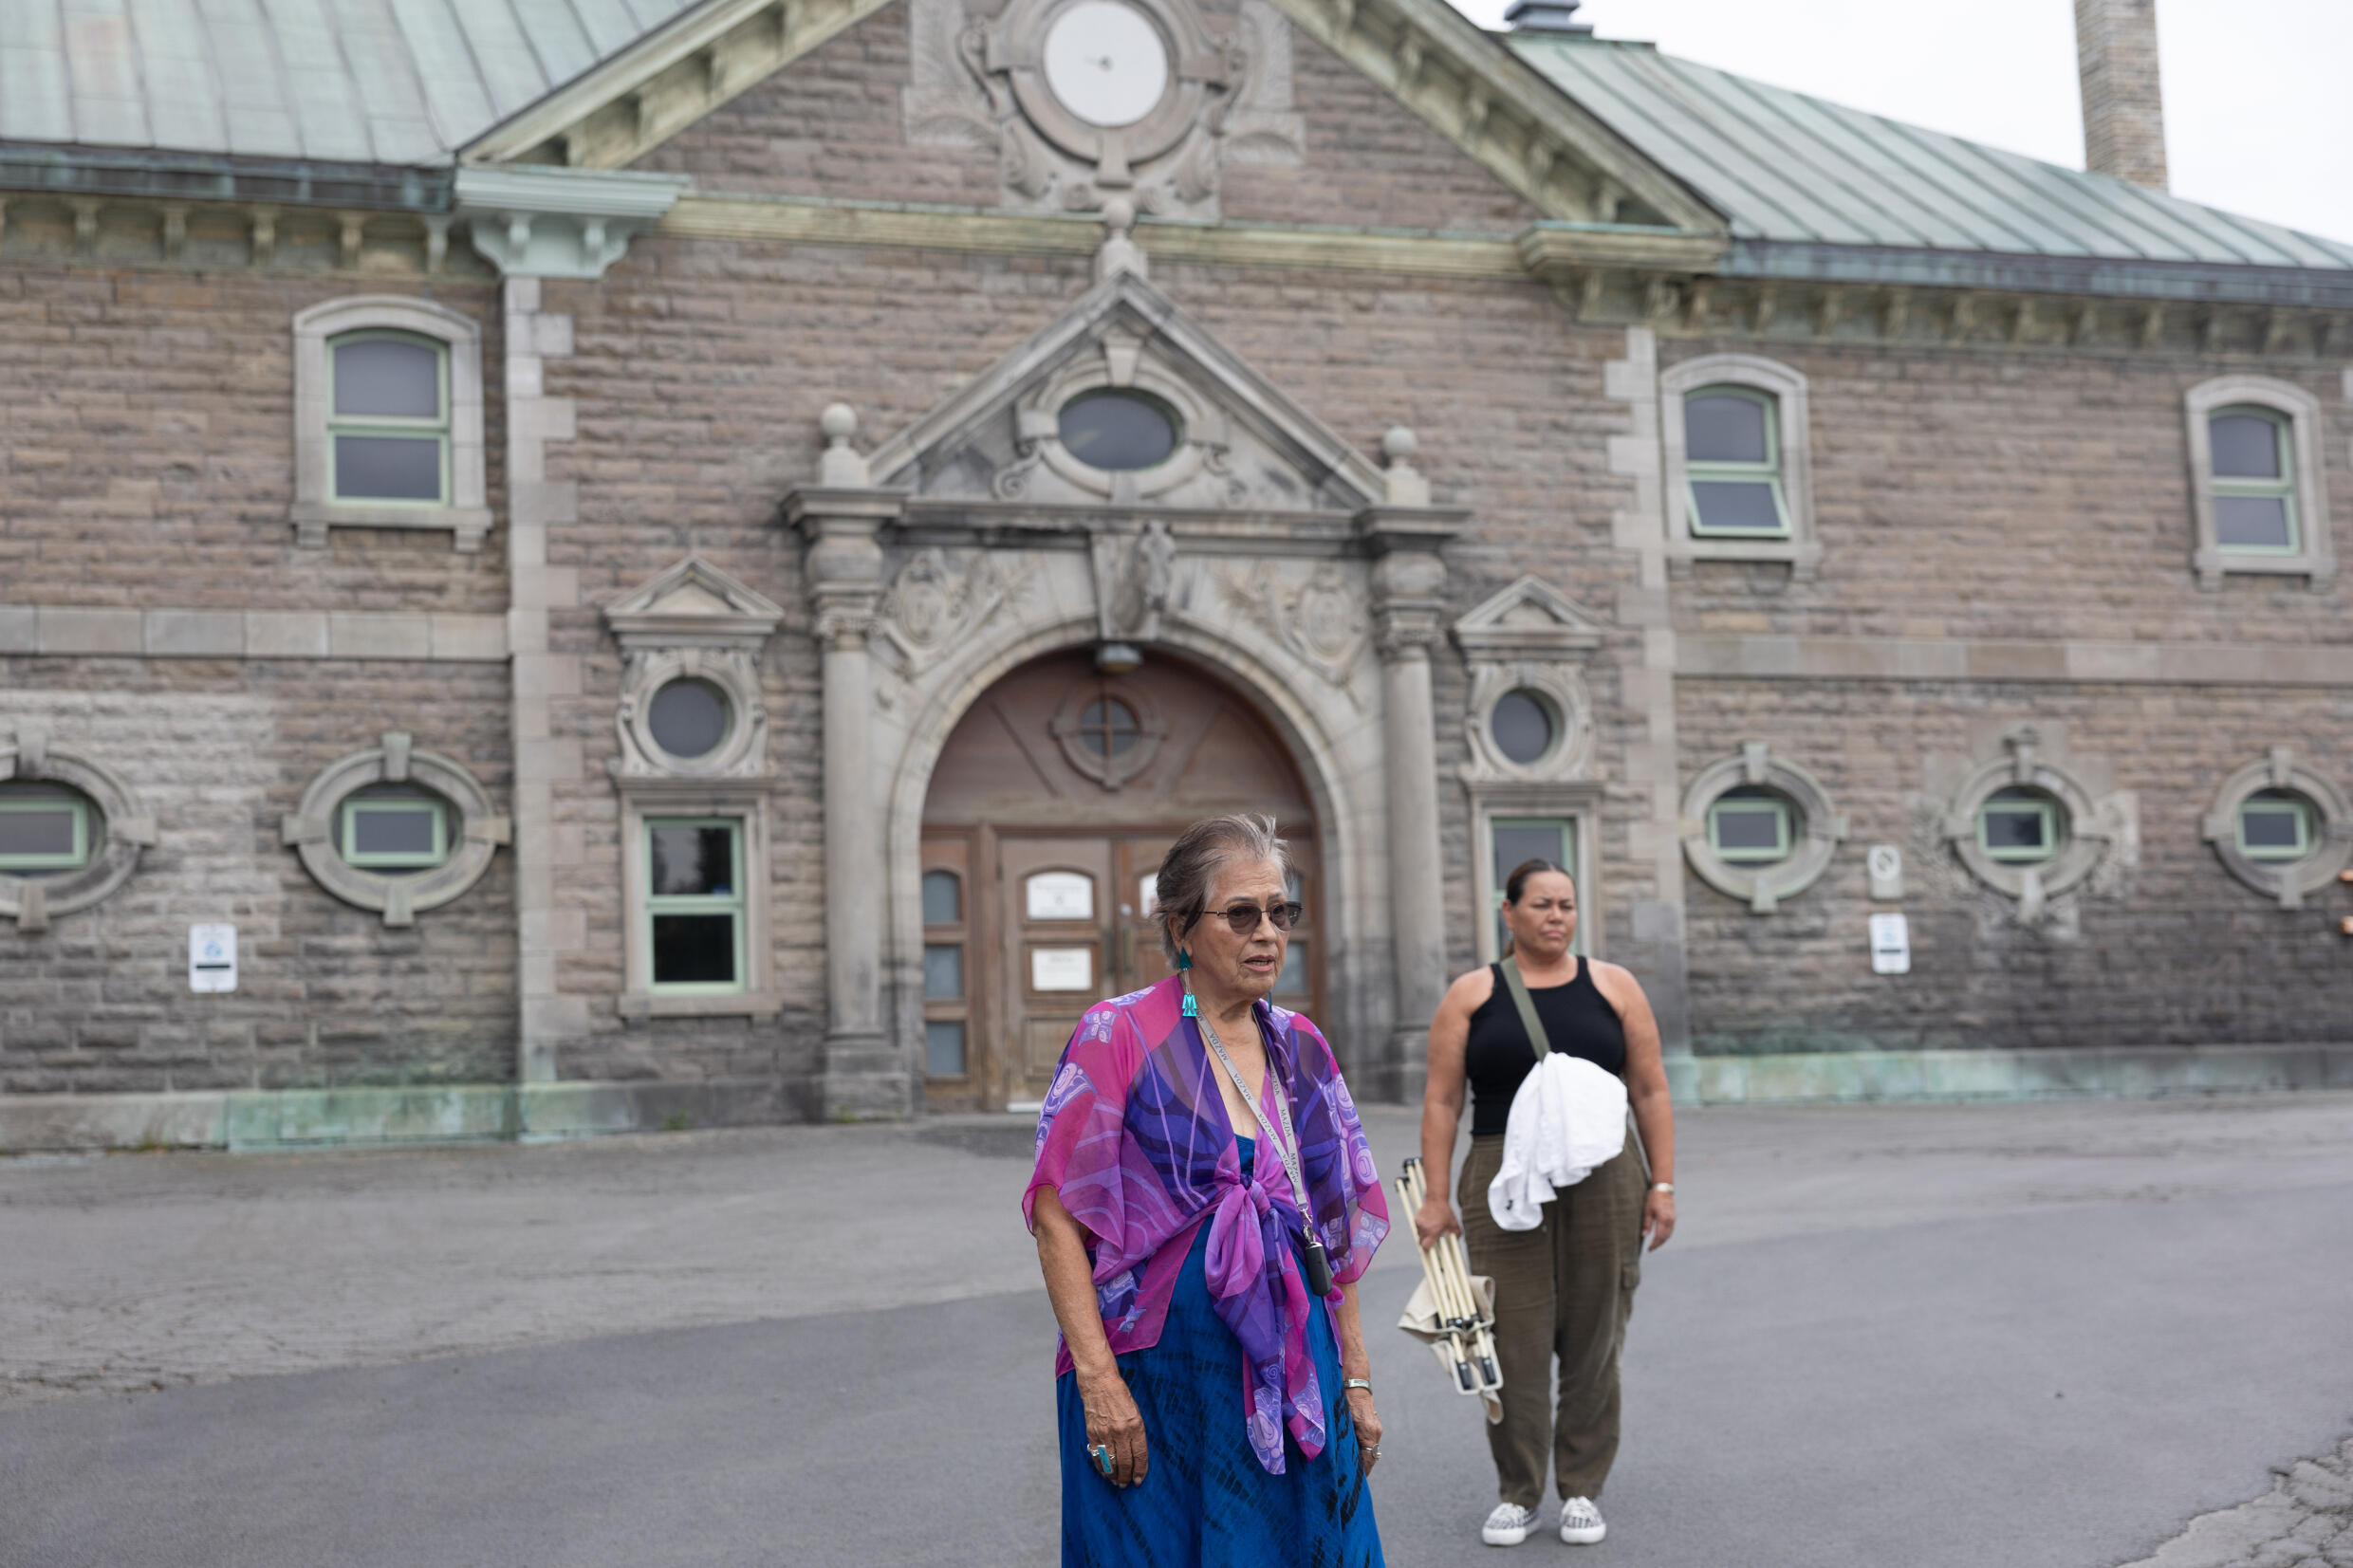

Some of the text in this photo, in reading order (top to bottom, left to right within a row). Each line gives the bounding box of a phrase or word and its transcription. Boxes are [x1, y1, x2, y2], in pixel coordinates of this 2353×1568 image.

[1210, 1033, 1229, 1061] MAZDA
[1233, 1073, 1252, 1100] MAZDA
[1258, 1114, 1277, 1140] MAZDA
[1280, 1108, 1291, 1137] MAZDA
[1283, 1153, 1299, 1183] MAZDA
